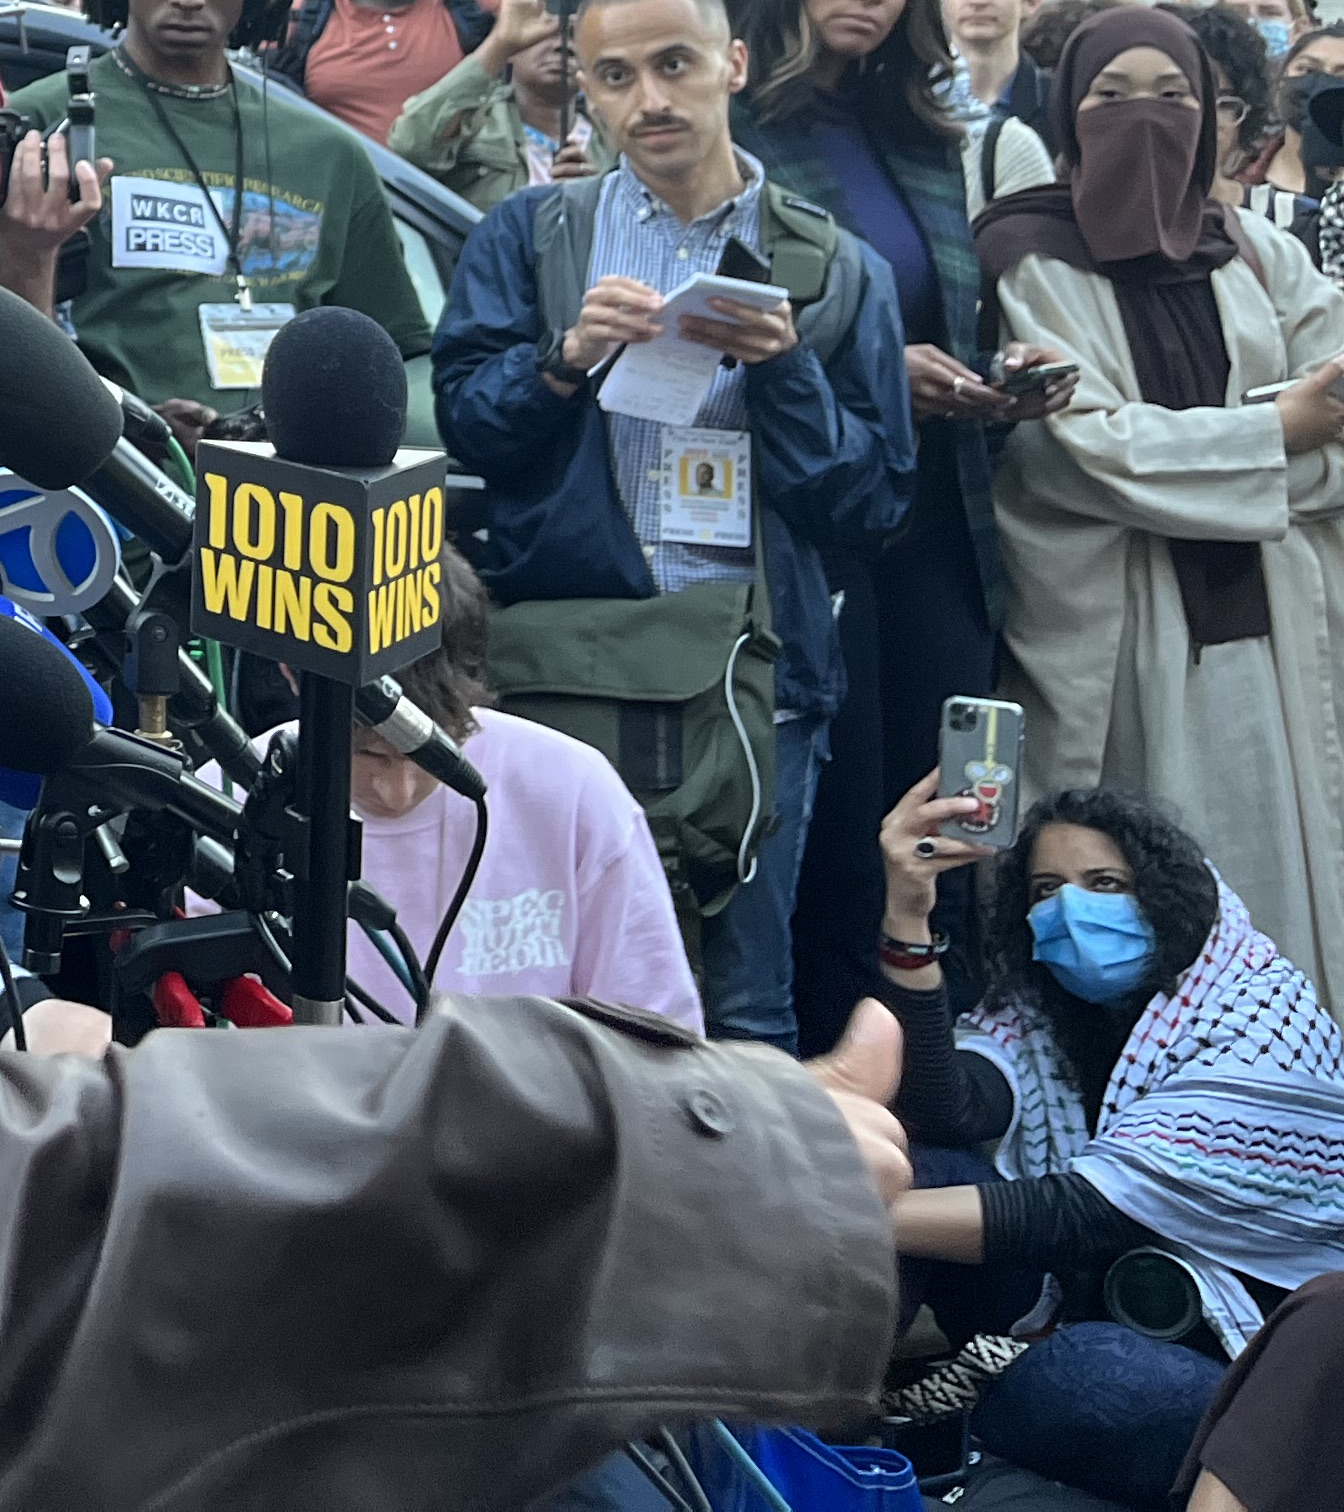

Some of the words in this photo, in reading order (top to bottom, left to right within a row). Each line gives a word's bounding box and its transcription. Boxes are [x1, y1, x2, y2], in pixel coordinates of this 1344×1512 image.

[128, 228, 214, 258] PRESS
[131, 198, 204, 226] WKCR
[204, 472, 355, 583] 1010
[372, 486, 443, 585] 1010
[200, 547, 354, 654] WINS
[368, 561, 441, 655] WINS
